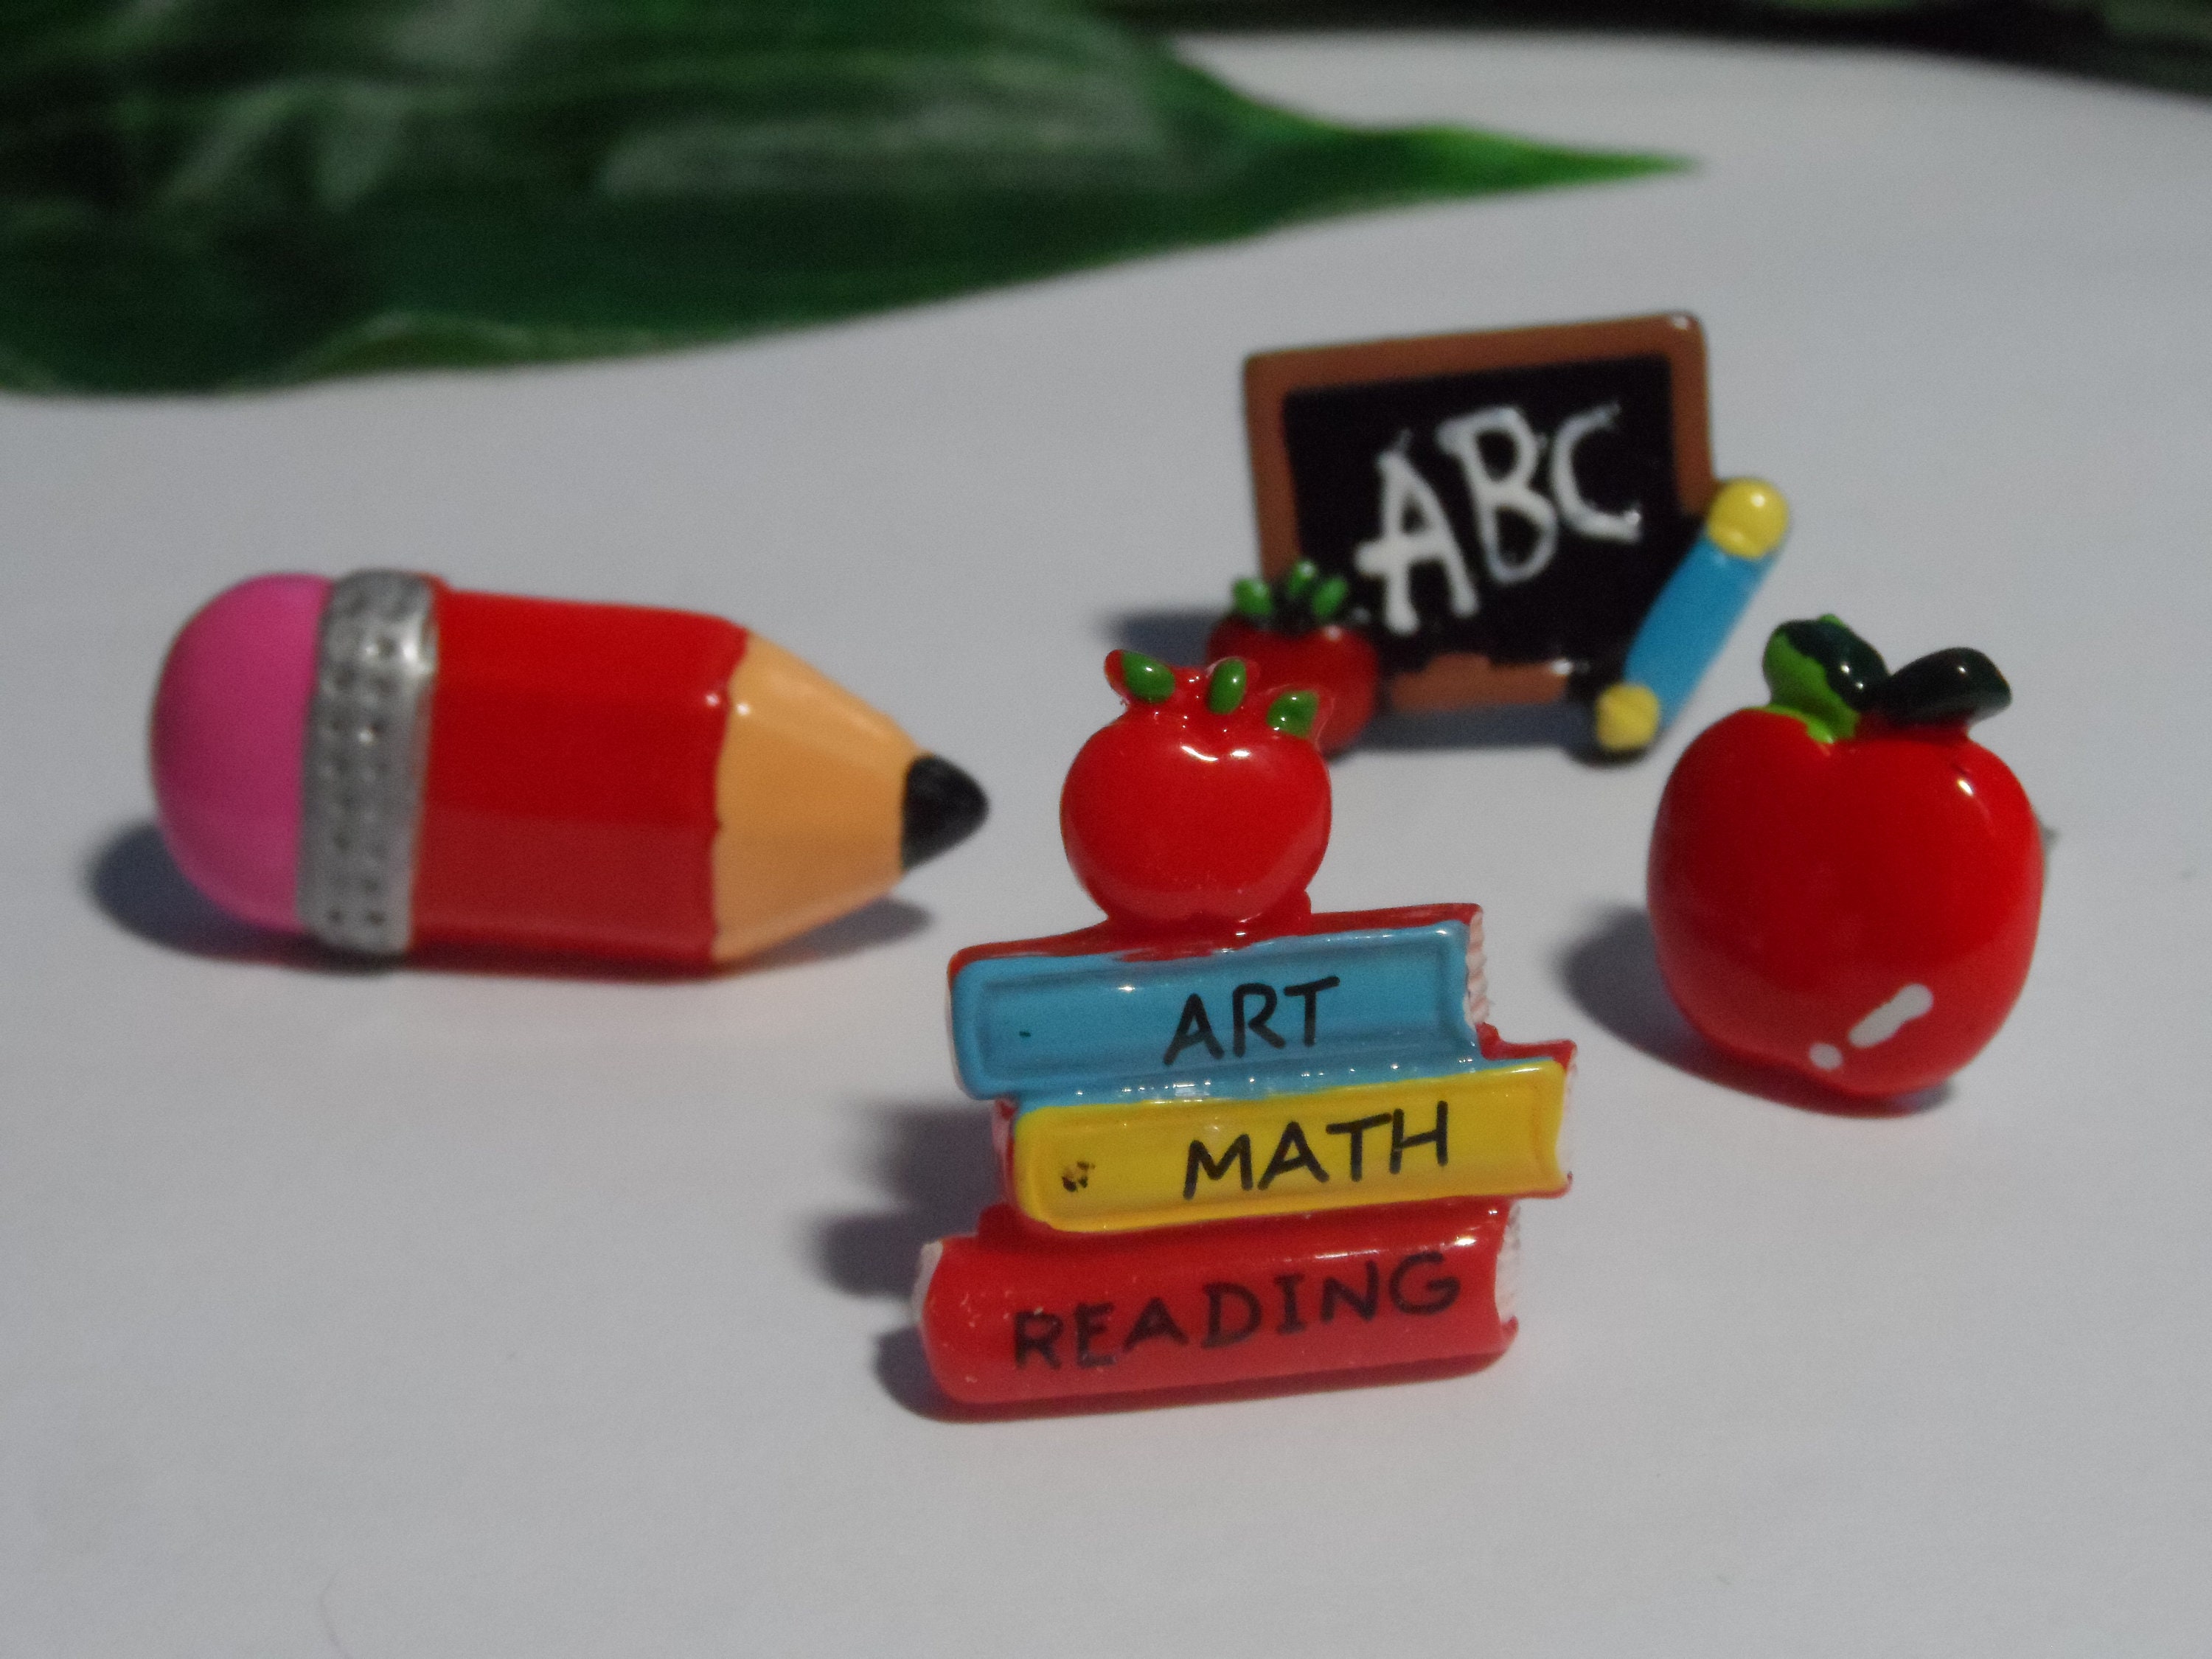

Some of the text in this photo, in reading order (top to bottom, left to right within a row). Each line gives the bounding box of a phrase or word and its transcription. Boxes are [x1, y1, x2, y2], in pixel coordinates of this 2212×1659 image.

[1354, 405, 1642, 633] ABC
[1165, 977, 1338, 1063] ART
[1185, 1102, 1450, 1197] MATH
[1017, 1251, 1460, 1369] READING
